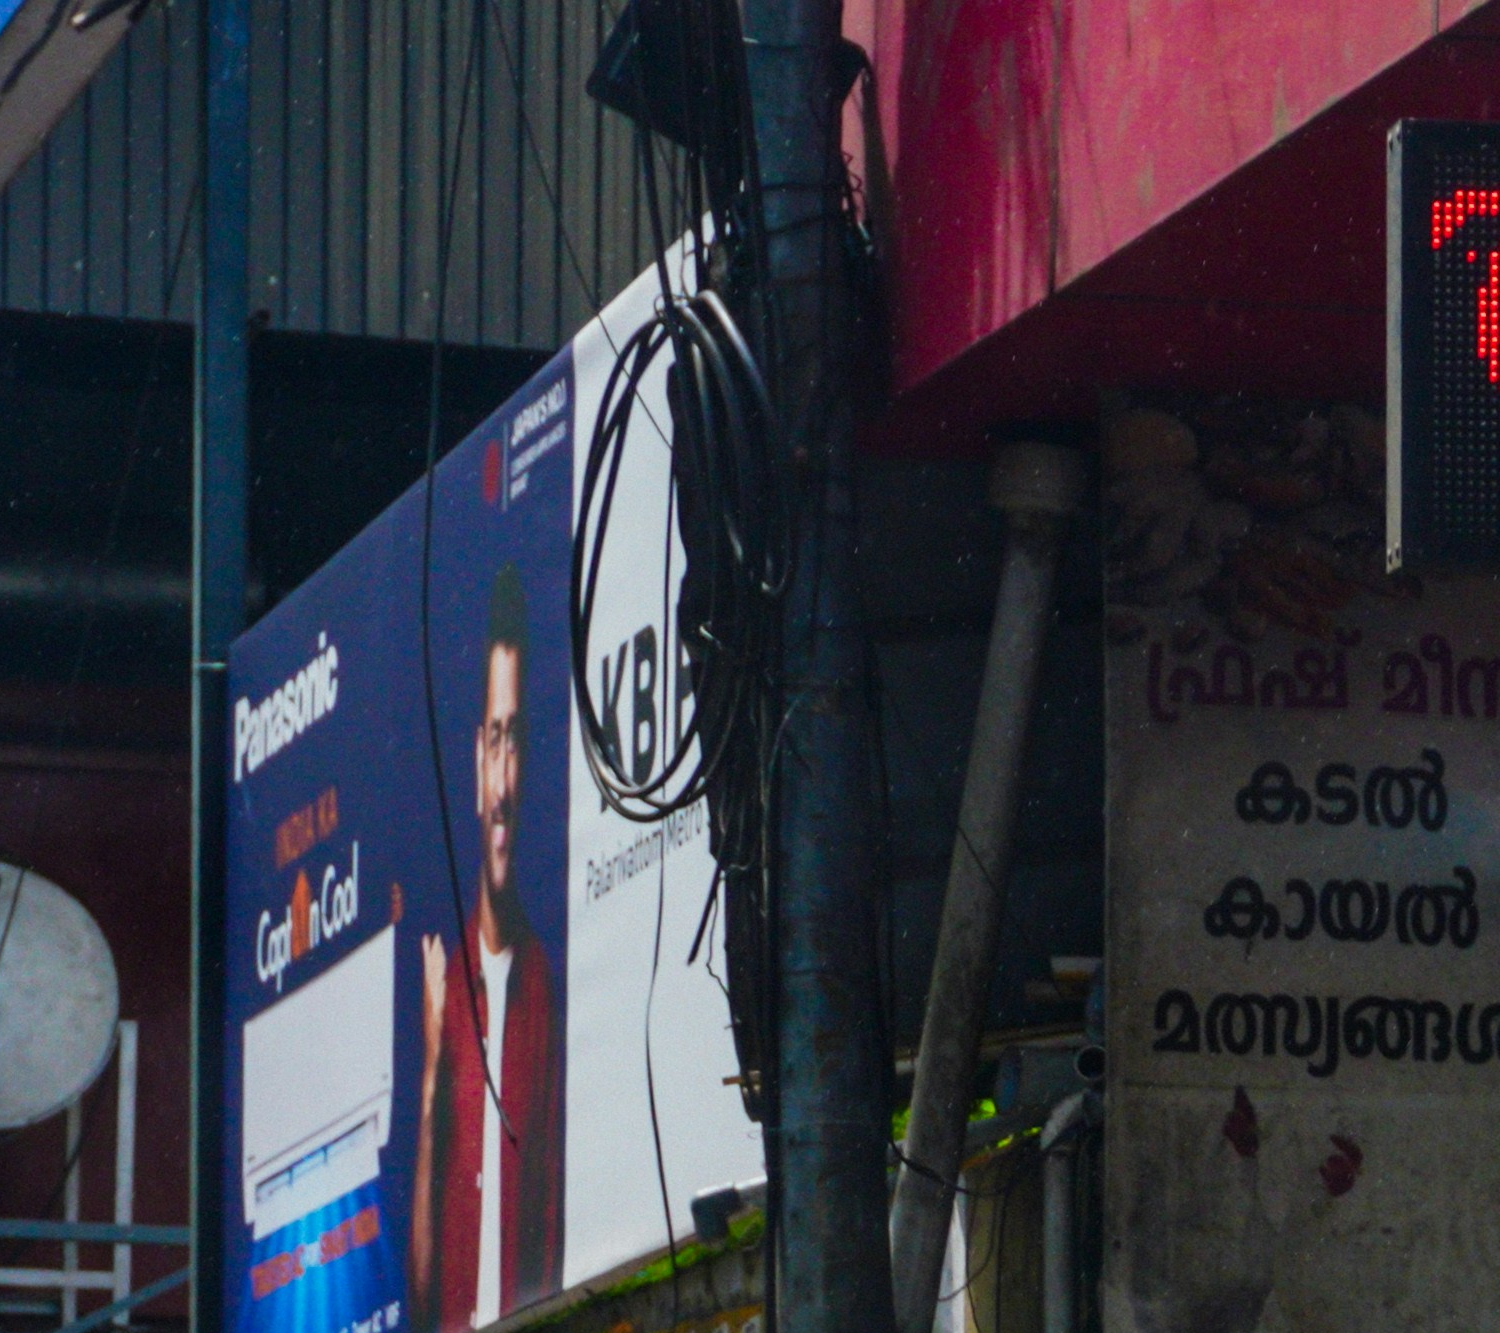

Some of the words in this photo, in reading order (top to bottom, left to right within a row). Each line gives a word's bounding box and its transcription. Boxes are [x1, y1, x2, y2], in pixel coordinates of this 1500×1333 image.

[233, 629, 339, 784] Panasonic
[600, 624, 658, 815] KB
[1234, 747, 1448, 833] കടൽ
[320, 839, 359, 940] Cool
[586, 830, 662, 906] Palarivattom
[664, 803, 704, 855] Metro
[1203, 865, 1481, 950] കായൽ
